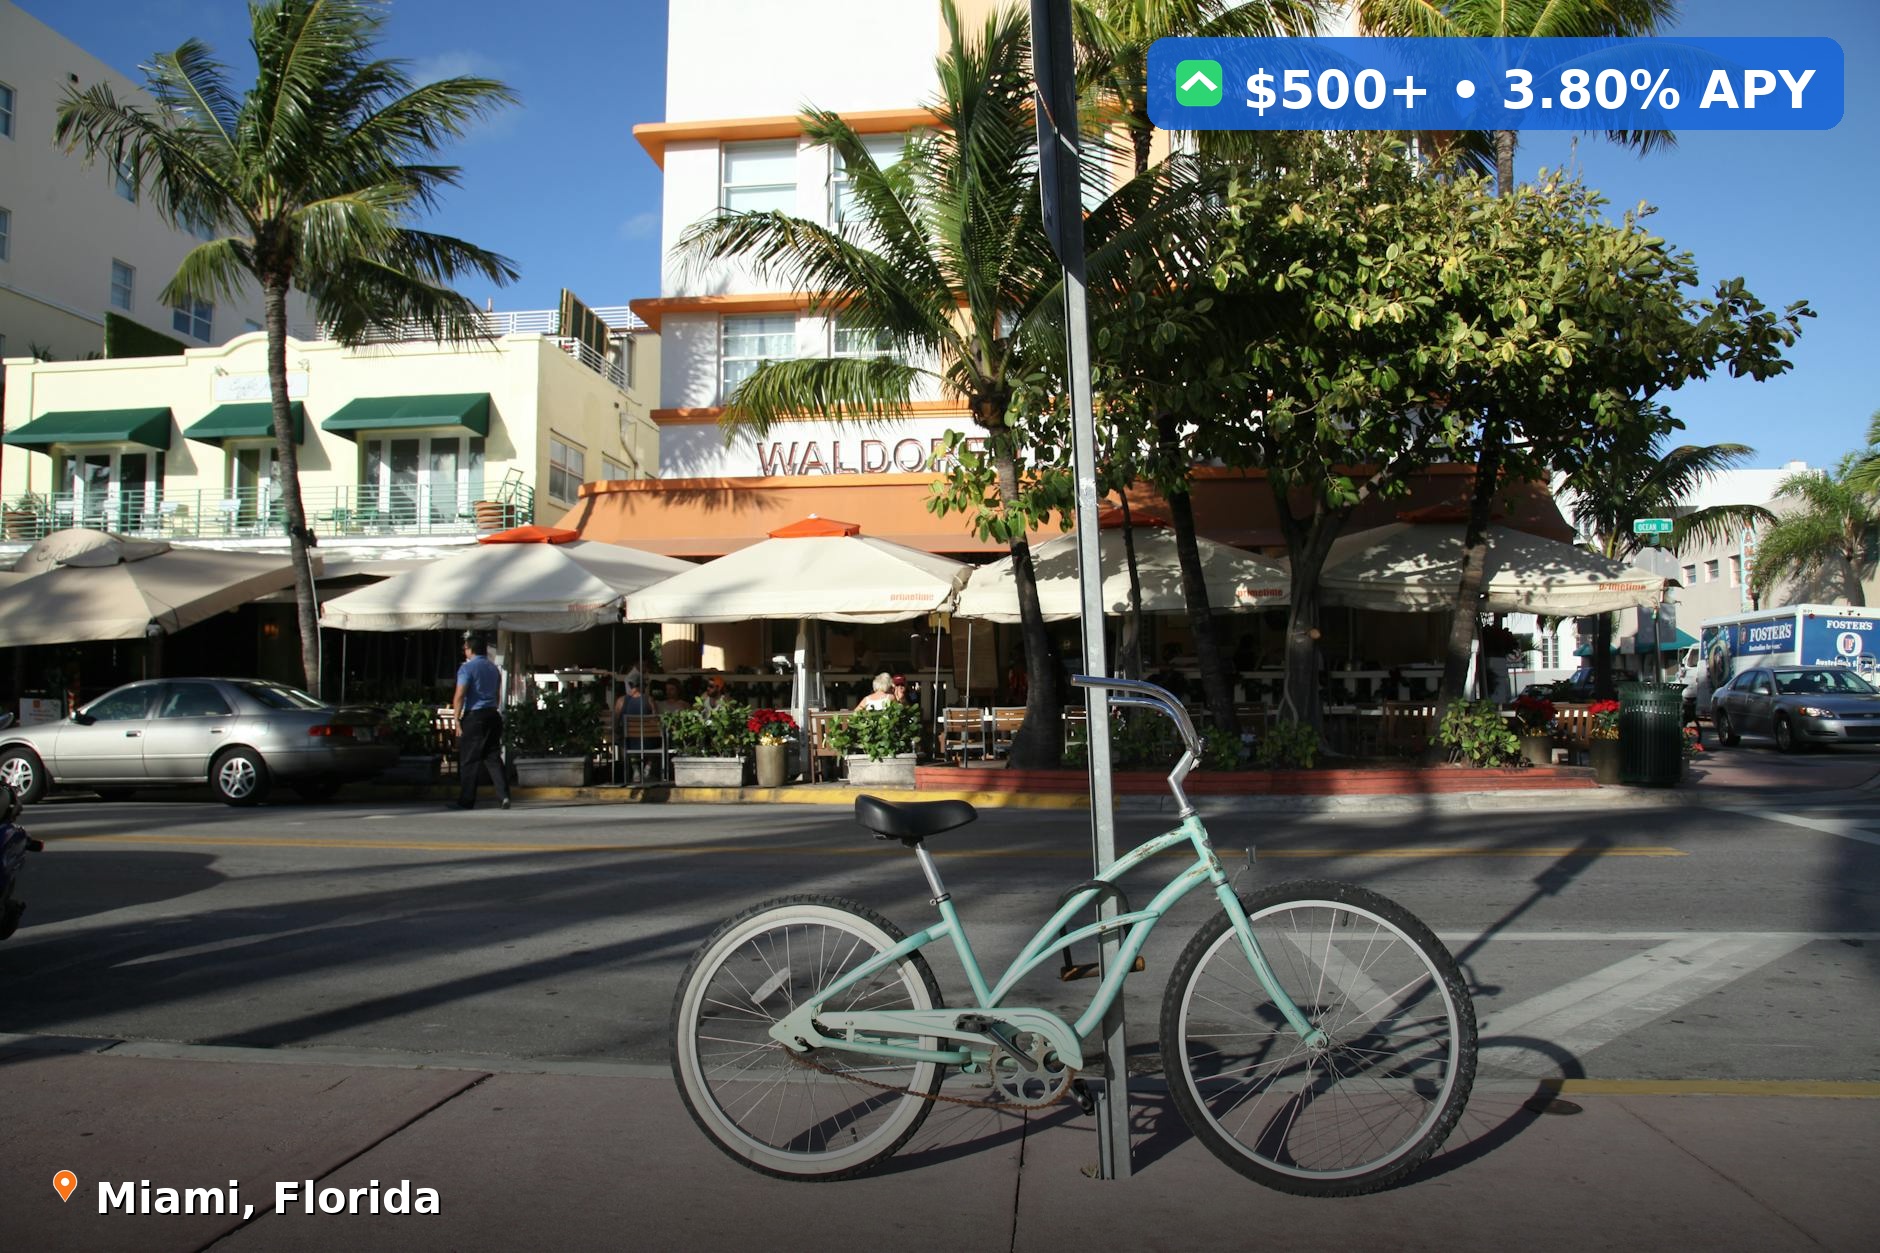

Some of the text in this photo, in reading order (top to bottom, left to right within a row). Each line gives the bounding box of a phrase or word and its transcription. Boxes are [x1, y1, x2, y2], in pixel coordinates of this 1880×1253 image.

[1638, 523, 1669, 531] OCEAN DR
[1826, 620, 1873, 631] FOSTER'S
[1749, 623, 1793, 642] FOSTER'S
